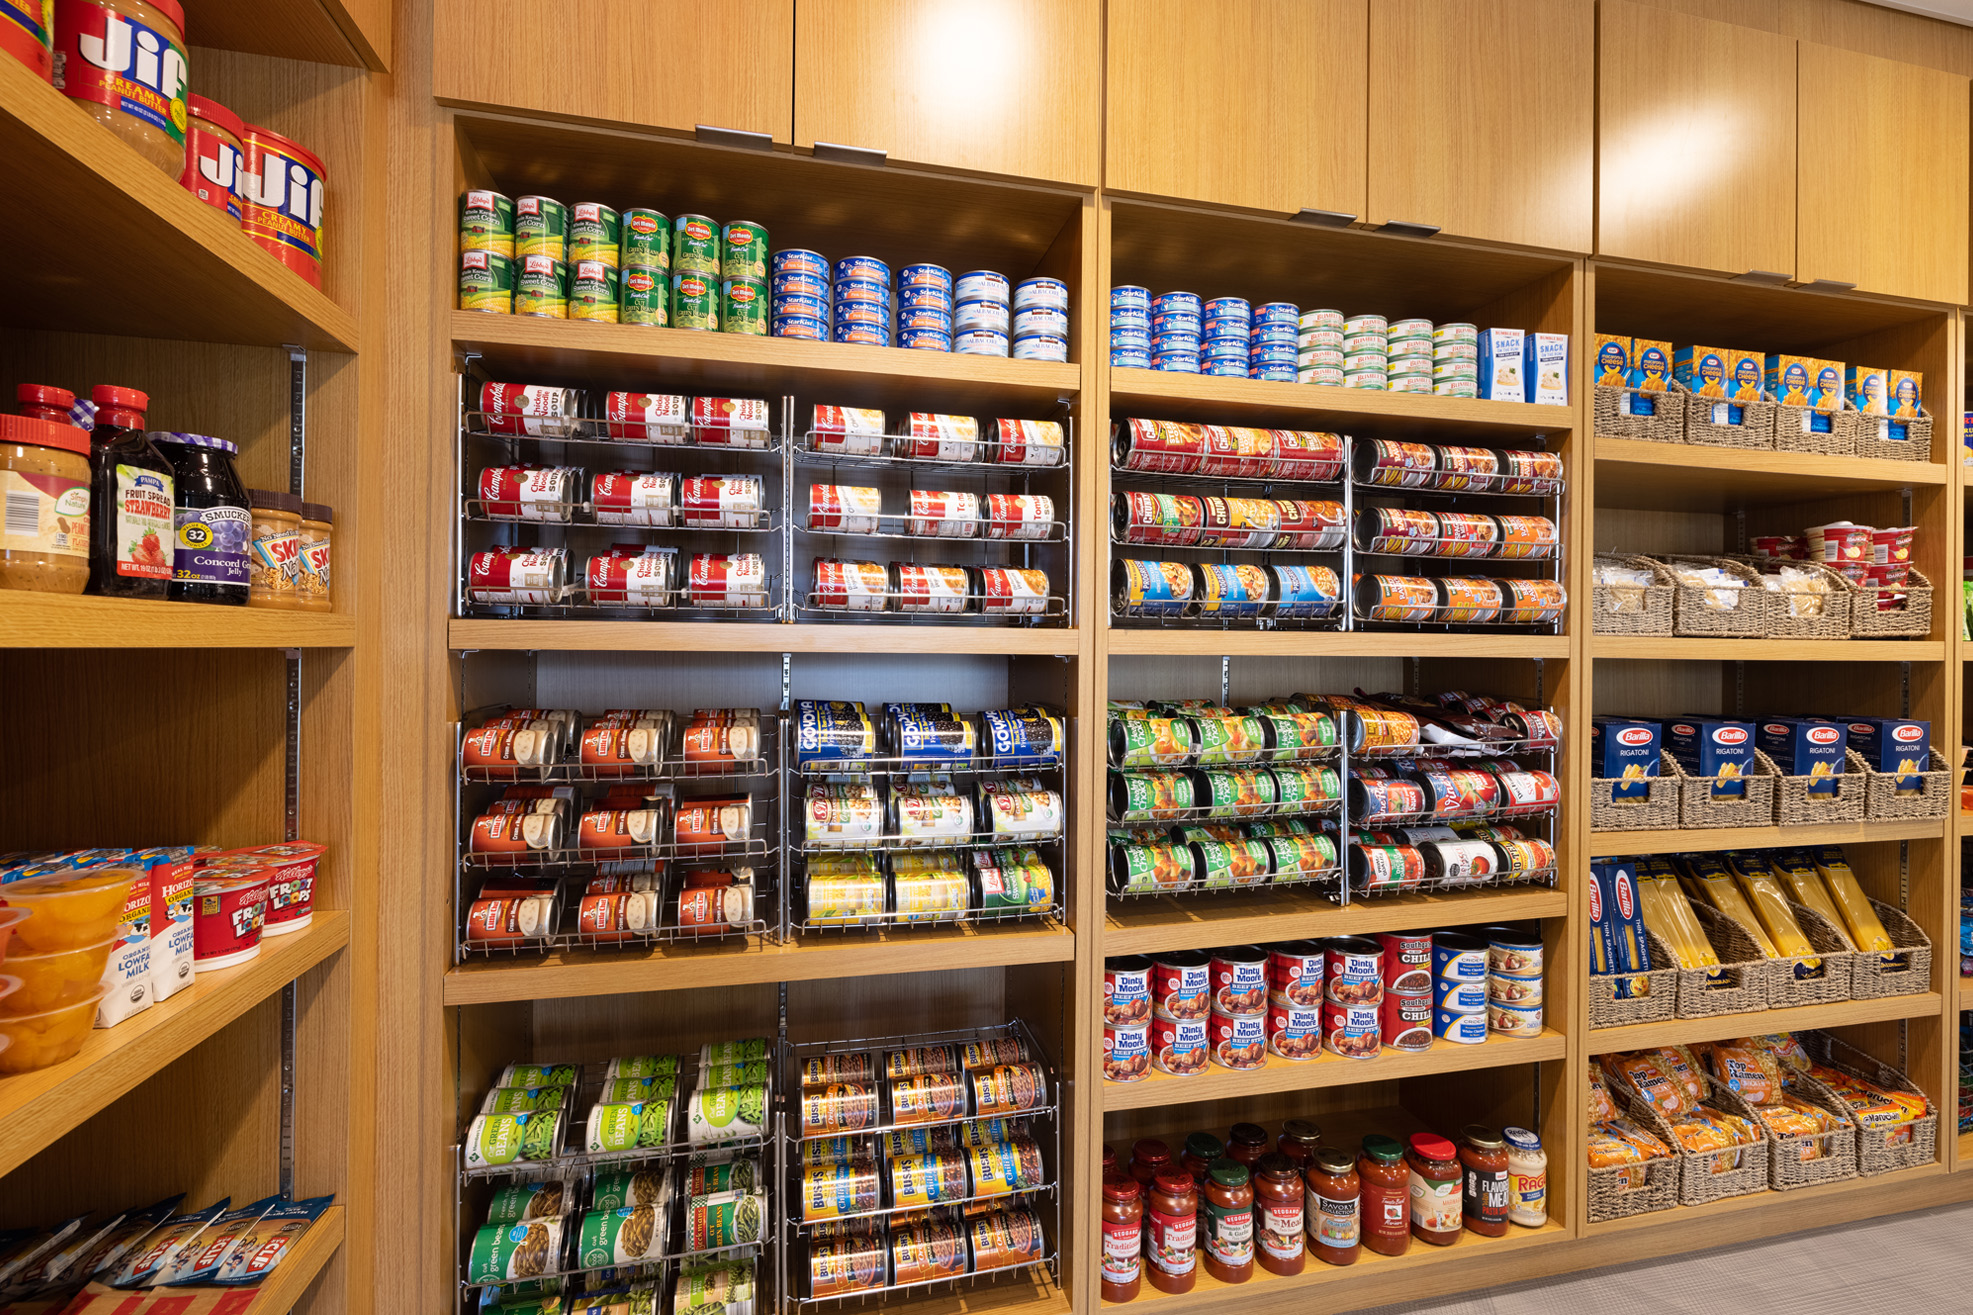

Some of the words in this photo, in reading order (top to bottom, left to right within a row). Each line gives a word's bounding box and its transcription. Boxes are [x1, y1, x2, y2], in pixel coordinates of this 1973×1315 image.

[79, 16, 188, 101] Jif
[105, 73, 163, 106] CREAMY
[99, 79, 137, 101] PEANUT
[138, 92, 167, 116] BUTTER
[243, 152, 324, 229] Jif
[262, 211, 308, 236] CREAMY
[644, 220, 657, 229] Monte
[257, 216, 288, 236] PEANUT
[288, 226, 311, 244] BUTTER
[697, 227, 711, 236] Monte
[787, 253, 813, 262] StarKist
[855, 260, 881, 269] StarKist
[541, 279, 560, 291] Corn
[640, 279, 653, 287] Monte
[787, 275, 813, 284] StarKist
[592, 285, 611, 297] Corn
[691, 284, 705, 292] Monte
[850, 282, 876, 291] StarKist
[786, 297, 812, 305] StarKist
[787, 318, 813, 326] StarKist
[1495, 339, 1520, 349] SNACK
[1540, 344, 1564, 353] SNACK
[551, 391, 560, 417] SOUP
[140, 476, 161, 487] PAMPA
[549, 471, 559, 492] SOUP
[125, 489, 146, 500] FRUIT
[148, 490, 171, 507] SPREAD
[124, 500, 171, 520] STRAWBERRY
[206, 510, 252, 523] SMUCKER
[188, 529, 205, 541] 32
[121, 563, 130, 571] NET
[194, 555, 240, 568] Concord
[227, 567, 243, 577] Jelly
[1625, 732, 1650, 741] Barilla
[1720, 731, 1747, 740] Barilla
[1814, 731, 1837, 740] Barilla
[1900, 729, 1921, 738] Barilla
[1620, 749, 1650, 757] RIGATONI
[275, 865, 314, 881] Kellogg's
[162, 878, 194, 898] HORIZO
[270, 877, 314, 897] FROOT
[168, 890, 194, 904] ORGANI
[273, 889, 311, 911] LOOPS
[1618, 881, 1631, 916] Barilla
[232, 903, 265, 926] FROO
[168, 934, 194, 949] LOWFA
[122, 946, 150, 960] ORGANI
[175, 943, 194, 956] MILK
[1638, 936, 1649, 971] SPAGHETTI
[118, 954, 150, 971] LOWFA
[1606, 939, 1616, 975] SPAGHETTI
[126, 962, 149, 979] MILK
[1349, 965, 1375, 975] Moore
[1351, 959, 1373, 970] Dinty
[1187, 971, 1207, 980] Dinty
[1239, 967, 1260, 976] Dinty
[1121, 977, 1143, 987] Dinty
[1185, 977, 1208, 987] Moore
[1236, 973, 1262, 983] Moore
[1119, 983, 1145, 993] Moore
[1294, 1012, 1315, 1021] Dinty
[1350, 1017, 1376, 1028] Moore
[1352, 1011, 1374, 1022] Dinty
[1239, 1022, 1260, 1031] Dinty
[1291, 1018, 1317, 1028] Moore
[1182, 1026, 1203, 1035] Dinty
[1237, 1028, 1262, 1038] Moore
[1121, 1032, 1143, 1042] Dinty
[1179, 1032, 1205, 1042] Moore
[1119, 1039, 1145, 1050] Moore
[1727, 1059, 1746, 1071] Top
[1628, 1070, 1648, 1081] Top
[1729, 1068, 1766, 1080] Ramen
[995, 1072, 1005, 1103] Original
[1636, 1077, 1668, 1088] Ramen
[917, 1080, 925, 1109] Original
[981, 1076, 992, 1103] BUSH'S
[827, 1092, 835, 1124] Original
[608, 1109, 618, 1135] GREEN
[1862, 1112, 1901, 1123] Maruchan
[488, 1118, 502, 1145] GREEN
[615, 1107, 628, 1146] BEANS
[496, 1117, 512, 1157] BEANS
[1004, 1161, 1013, 1181] Chili
[901, 1159, 915, 1196] BUSH'S
[813, 1171, 825, 1209] BUSH'S
[925, 1175, 935, 1195] Chili
[1518, 1177, 1546, 1191] RAG
[838, 1188, 847, 1209] Chili
[1322, 1200, 1354, 1210] SAVORY
[1482, 1207, 1497, 1215] PASTA
[1273, 1208, 1300, 1216] REGGANO
[1322, 1207, 1355, 1216] COLLECTION
[1226, 1214, 1251, 1223] REGGANO
[1281, 1219, 1302, 1228] Meat
[1174, 1220, 1196, 1230] REGGANO
[599, 1220, 608, 1246] green
[994, 1217, 1003, 1246] Original
[1114, 1230, 1139, 1238] REGGANO
[915, 1231, 924, 1261] Original
[1106, 1240, 1140, 1250] Traditiona
[199, 1243, 225, 1267] CLIF
[251, 1243, 279, 1268] CLIF
[490, 1246, 499, 1272] green
